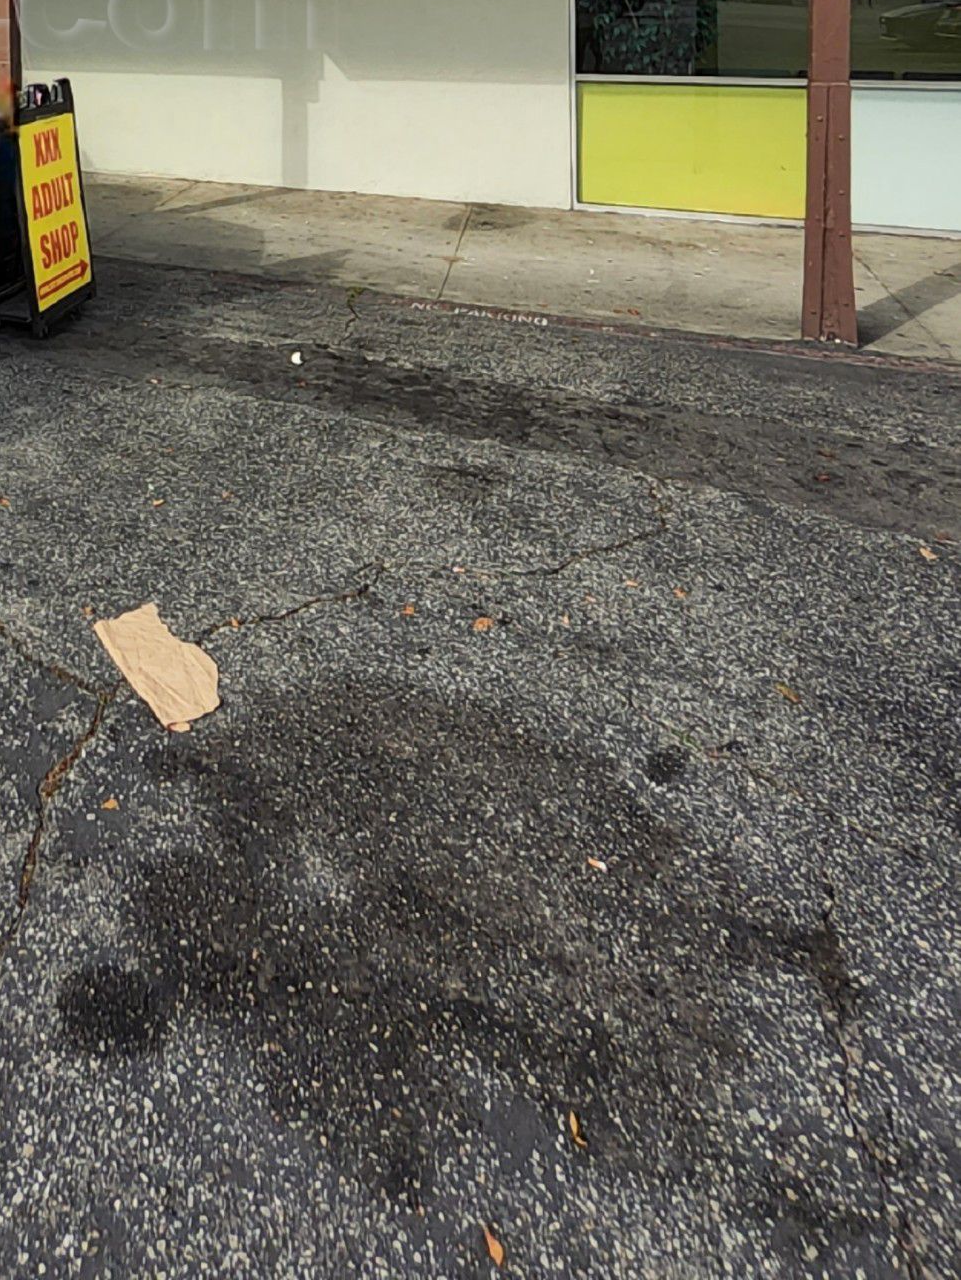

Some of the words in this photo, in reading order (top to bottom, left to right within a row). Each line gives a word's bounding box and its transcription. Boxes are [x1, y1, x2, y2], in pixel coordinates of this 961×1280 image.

[33, 127, 62, 168] XXX
[31, 172, 75, 221] ADULT
[40, 221, 79, 269] SHOP
